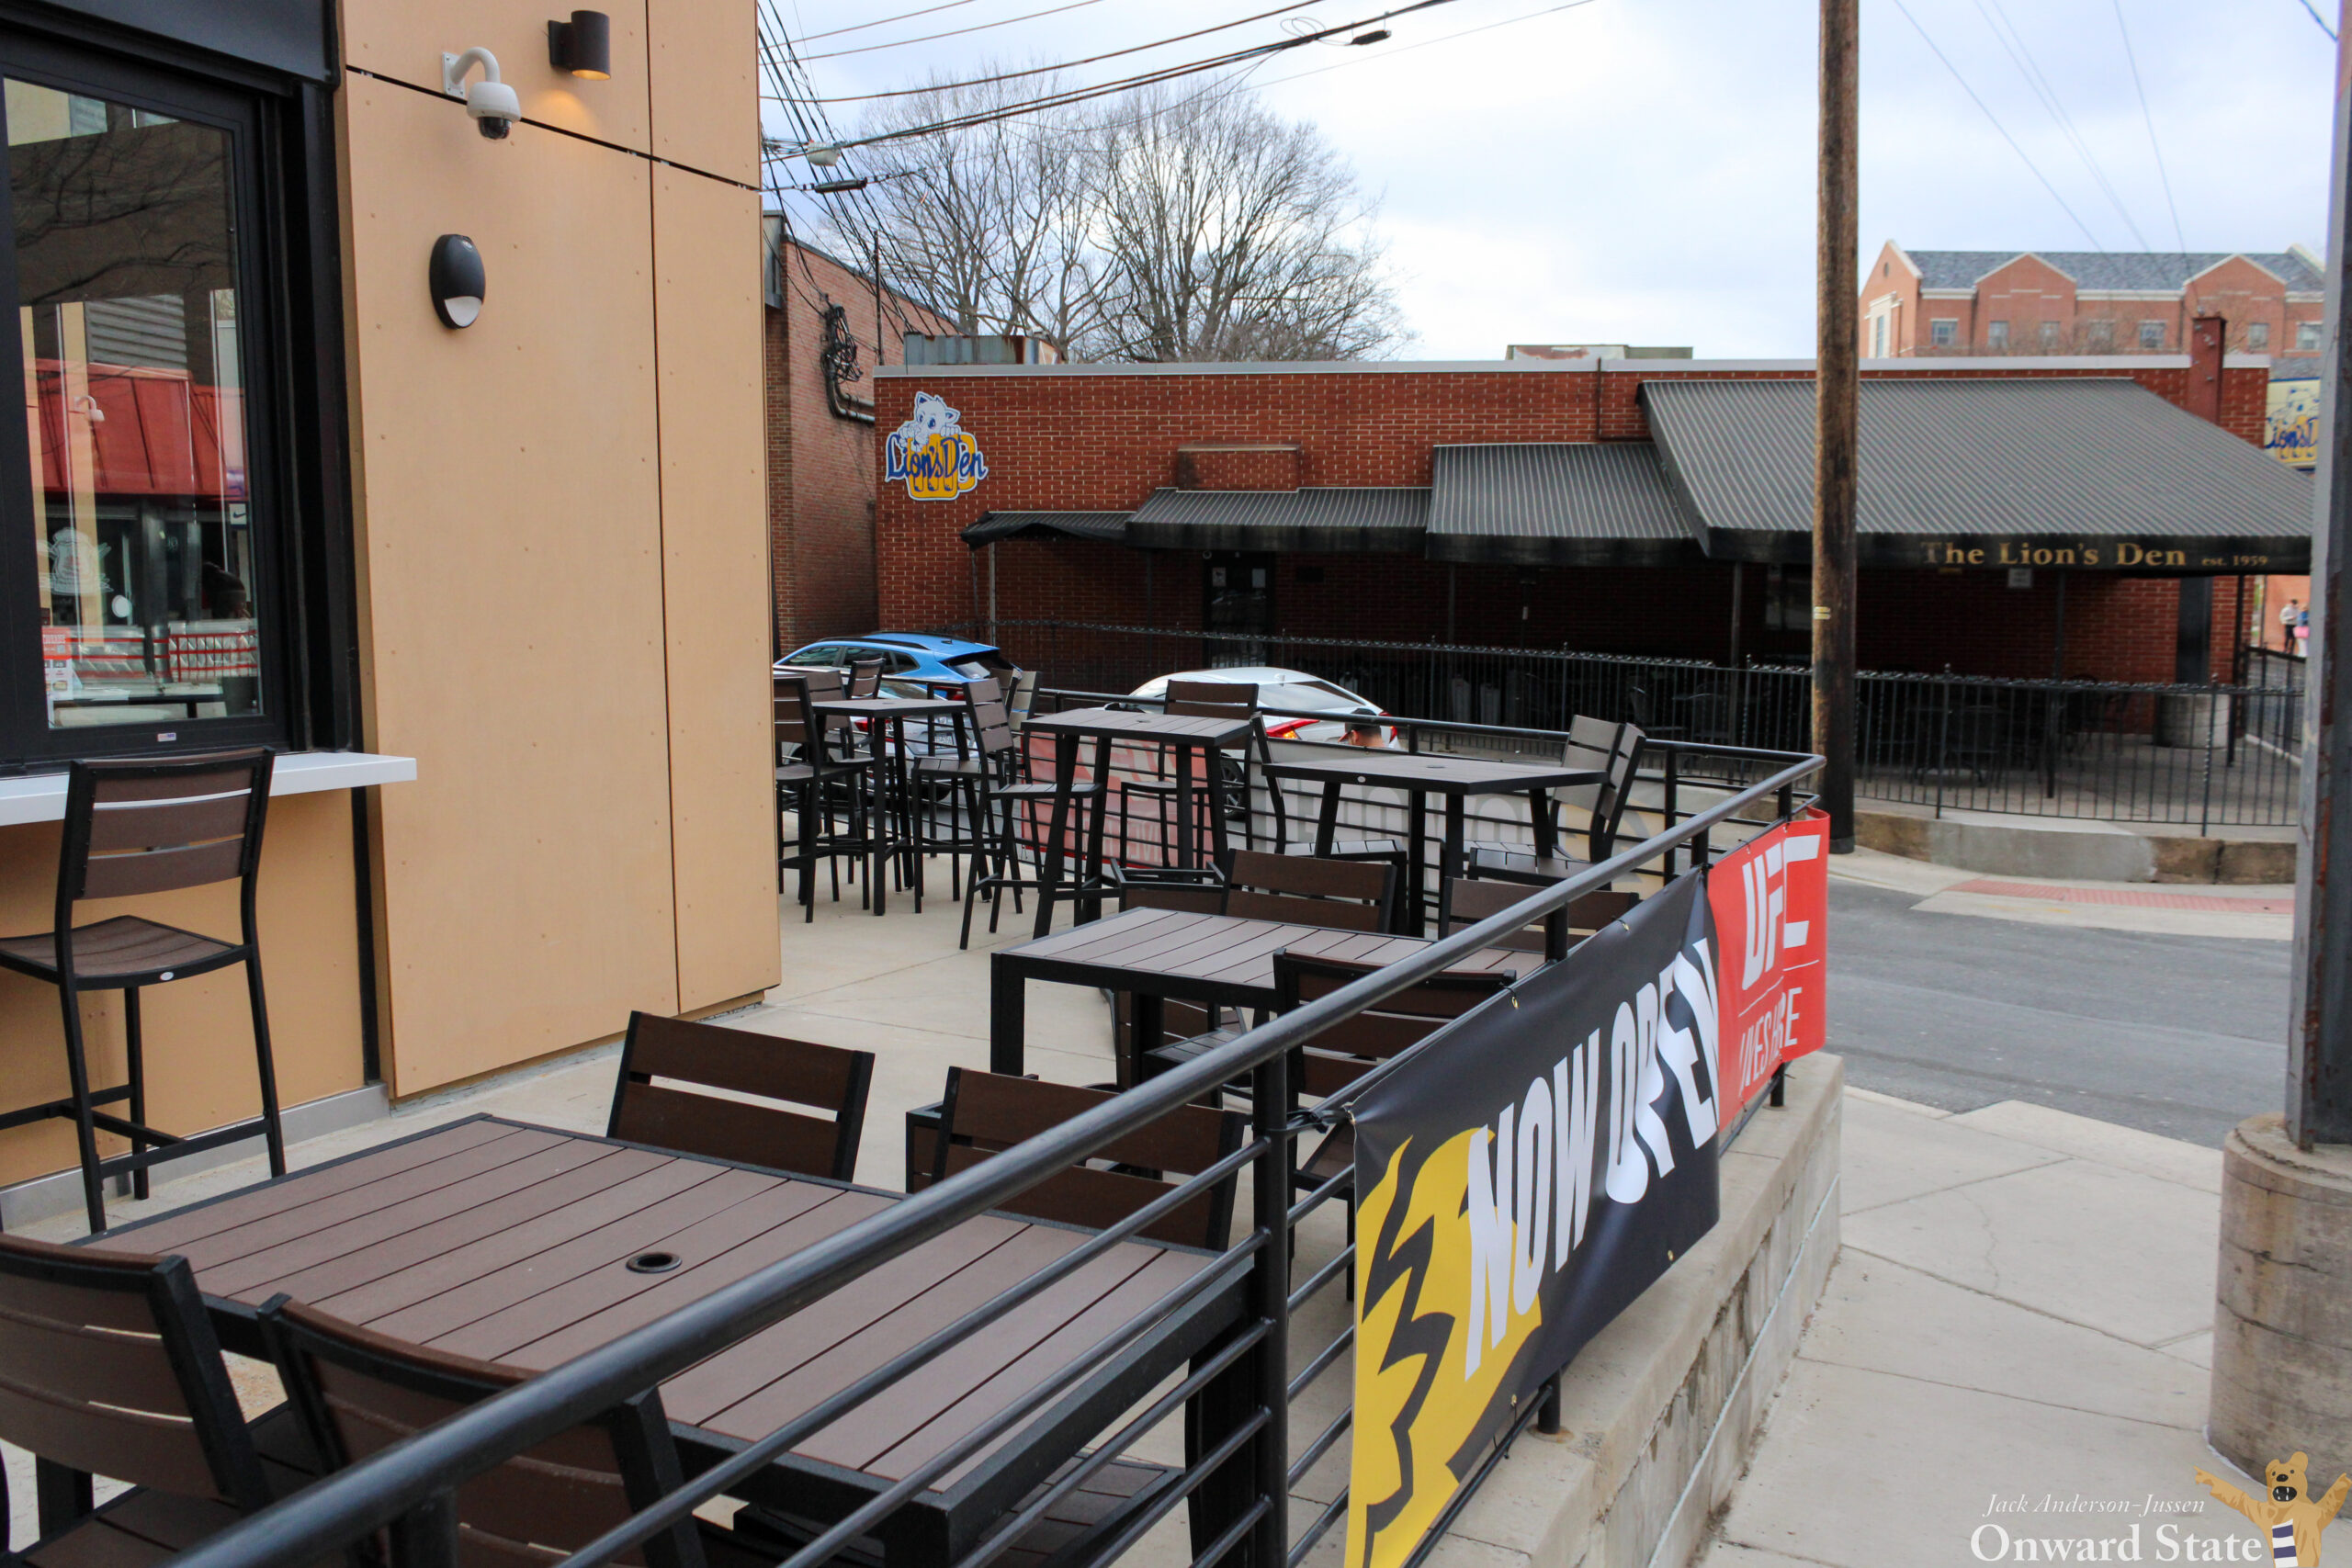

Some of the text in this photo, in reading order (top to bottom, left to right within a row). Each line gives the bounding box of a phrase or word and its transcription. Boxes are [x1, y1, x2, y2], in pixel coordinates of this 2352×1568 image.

[887, 434, 987, 479] Lion's Den
[2266, 418, 2307, 449] ion's
[1920, 541, 2268, 567] The Lion's Den est. 1959
[1742, 834, 1821, 991] UFC
[1769, 986, 1803, 1065] HRE
[1464, 937, 1719, 1382] NOW OPEN
